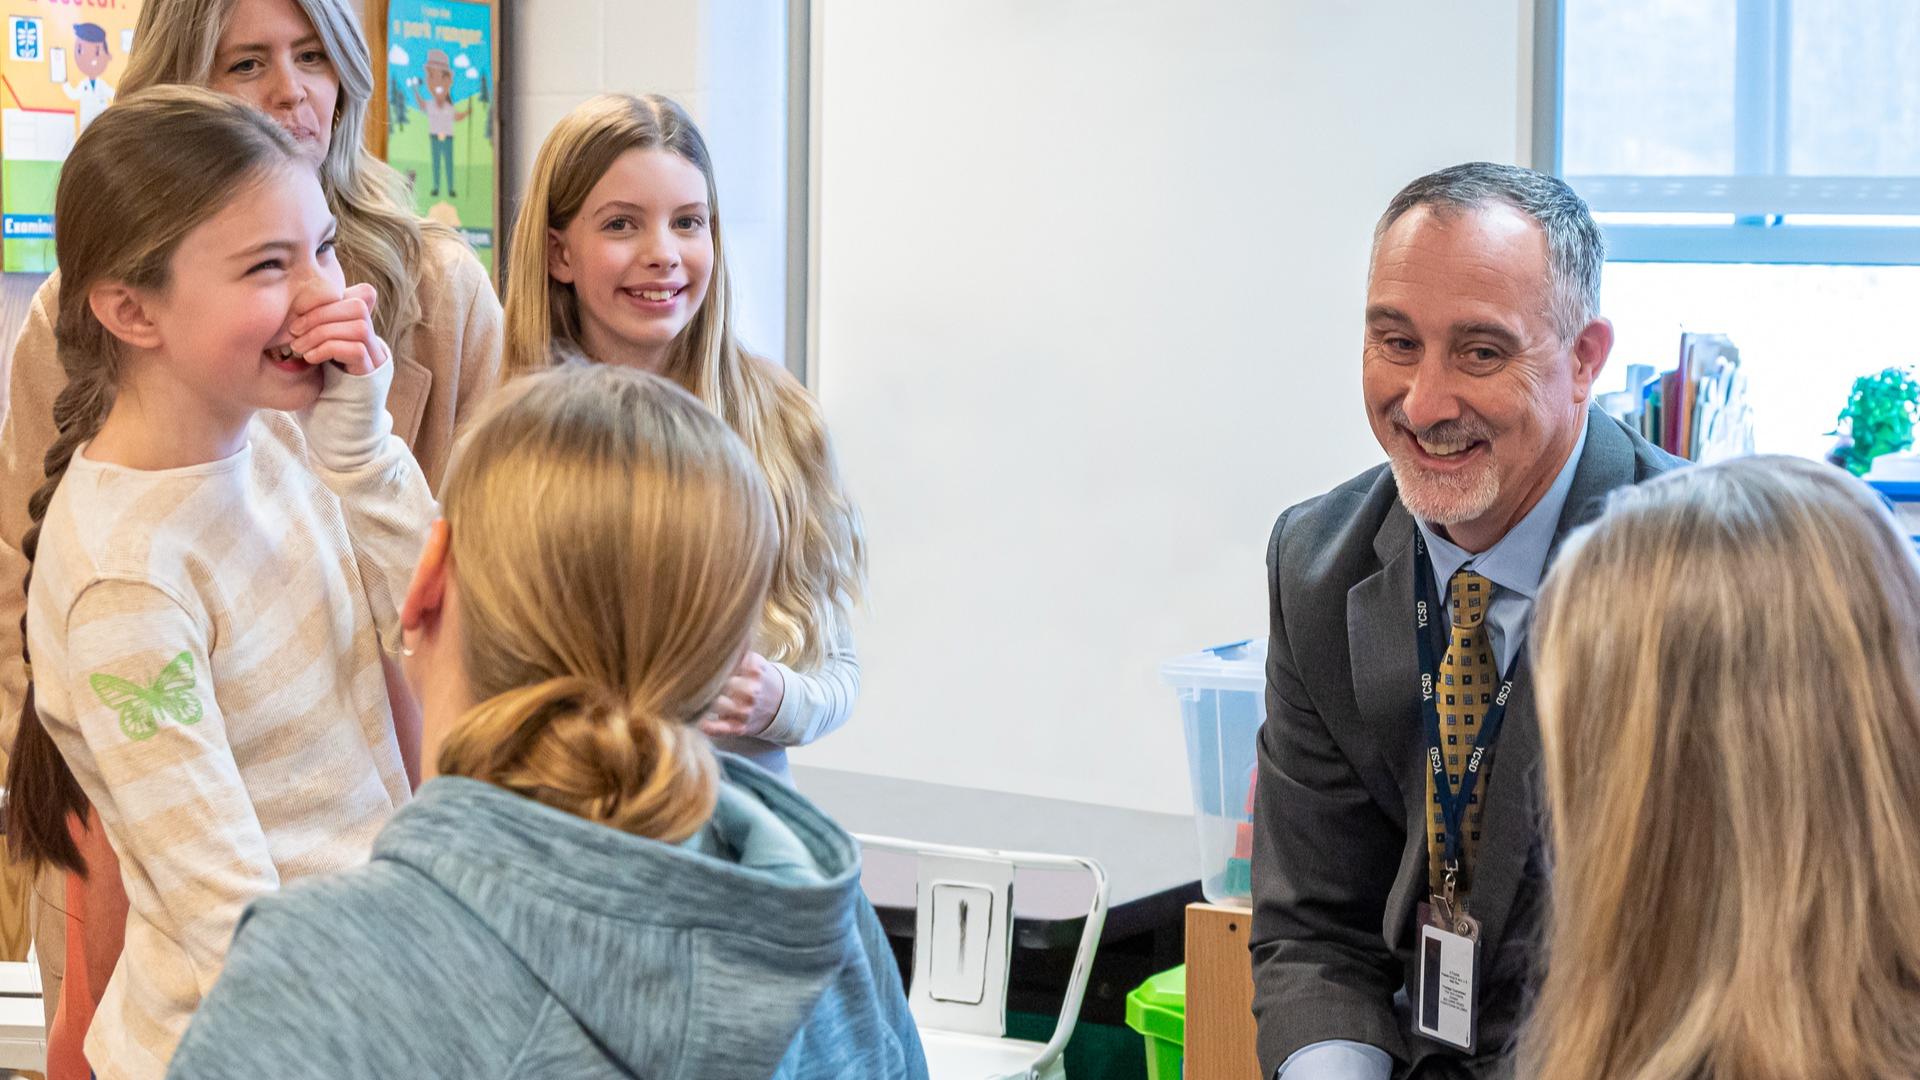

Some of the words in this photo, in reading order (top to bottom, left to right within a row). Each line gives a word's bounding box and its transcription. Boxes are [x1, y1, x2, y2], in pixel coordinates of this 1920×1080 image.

[1417, 601, 1428, 629] YCSD
[1421, 673, 1433, 701] YCSD
[1496, 680, 1513, 706] YCSD
[1429, 746, 1443, 774] YCSD
[1468, 746, 1485, 774] YCSD
